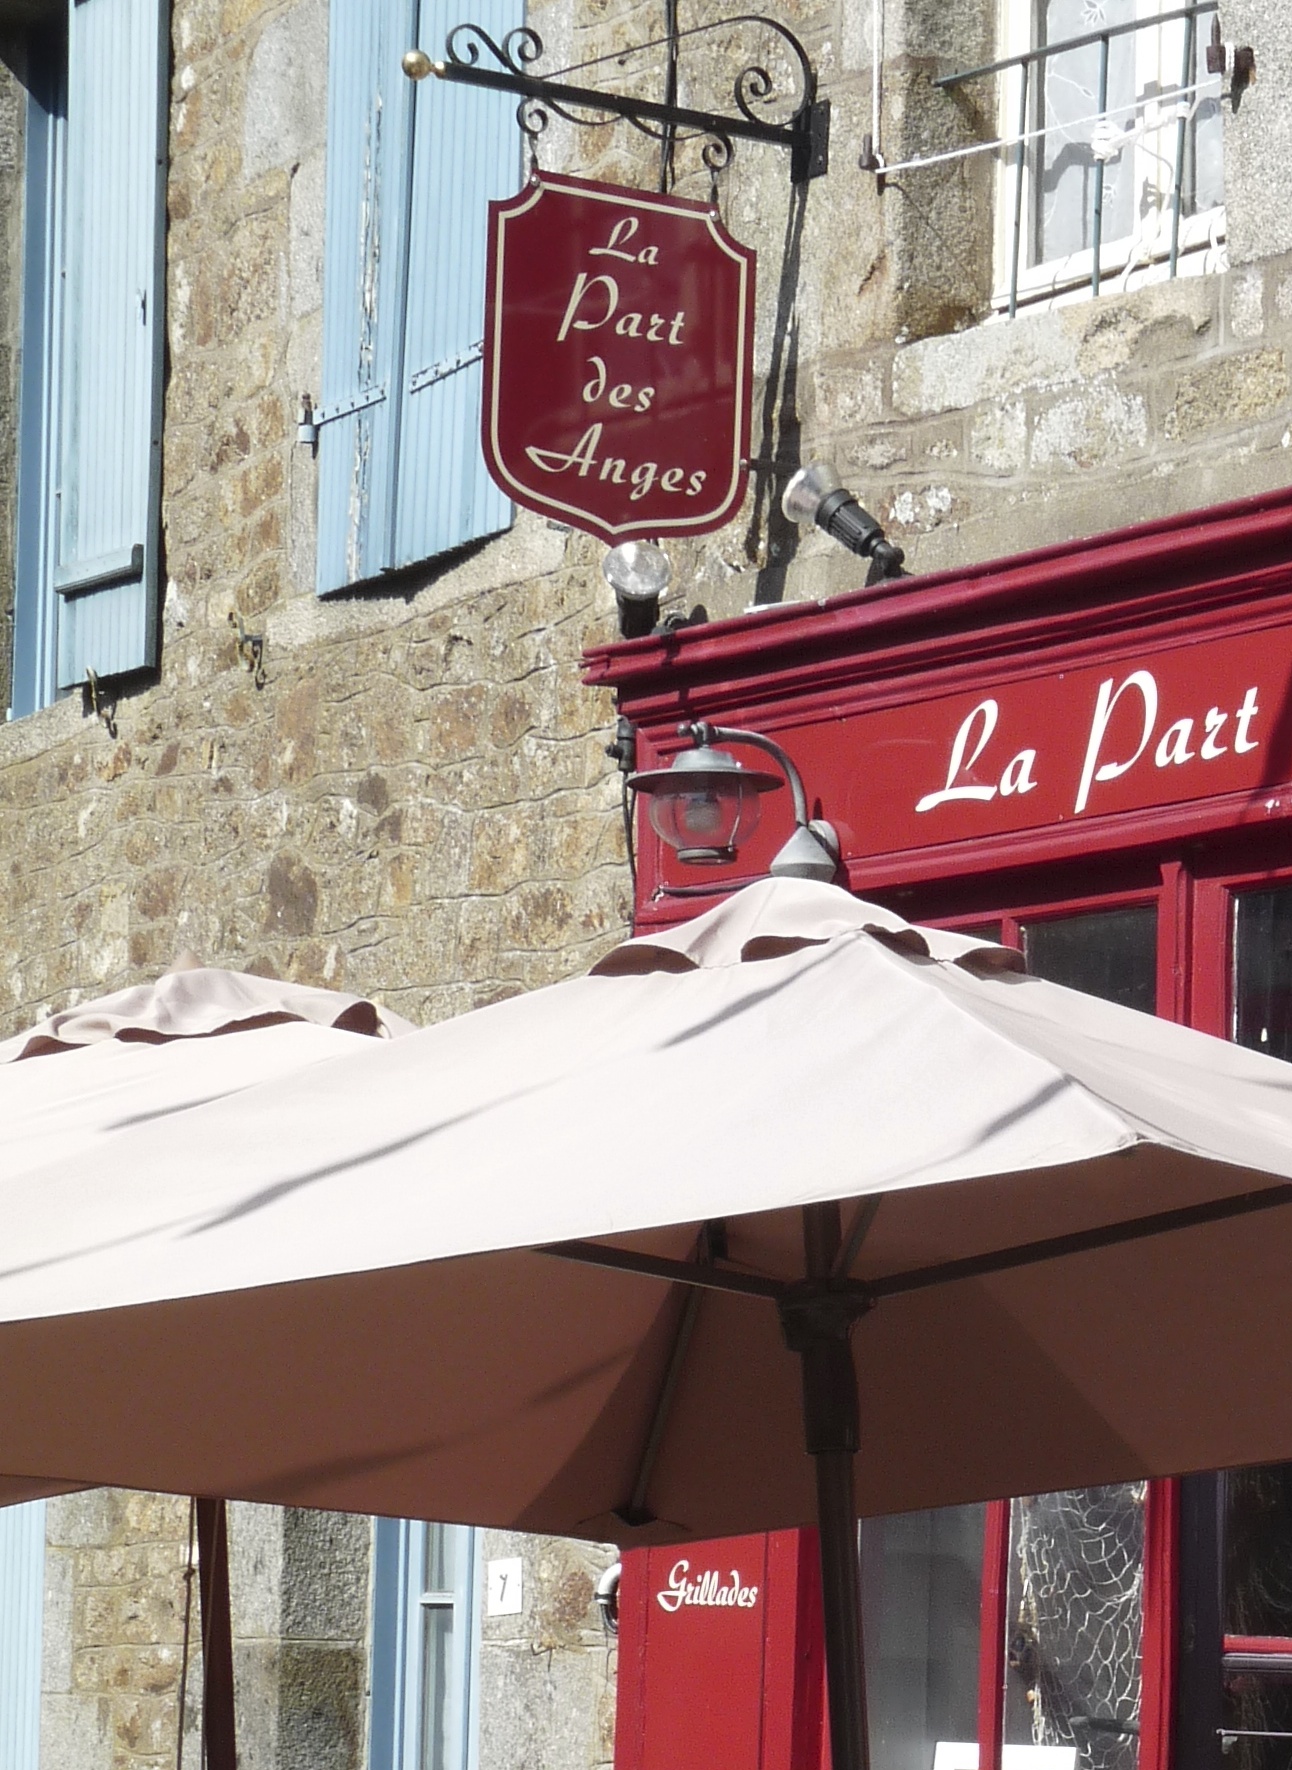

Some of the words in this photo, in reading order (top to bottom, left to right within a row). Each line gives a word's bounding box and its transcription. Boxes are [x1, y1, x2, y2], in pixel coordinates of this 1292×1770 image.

[589, 217, 659, 265] La
[557, 272, 685, 344] Part
[582, 356, 655, 412] des
[525, 422, 707, 500] Anges
[915, 699, 1037, 812] La
[1074, 669, 1259, 814] Part
[657, 1559, 759, 1612] Grillades
